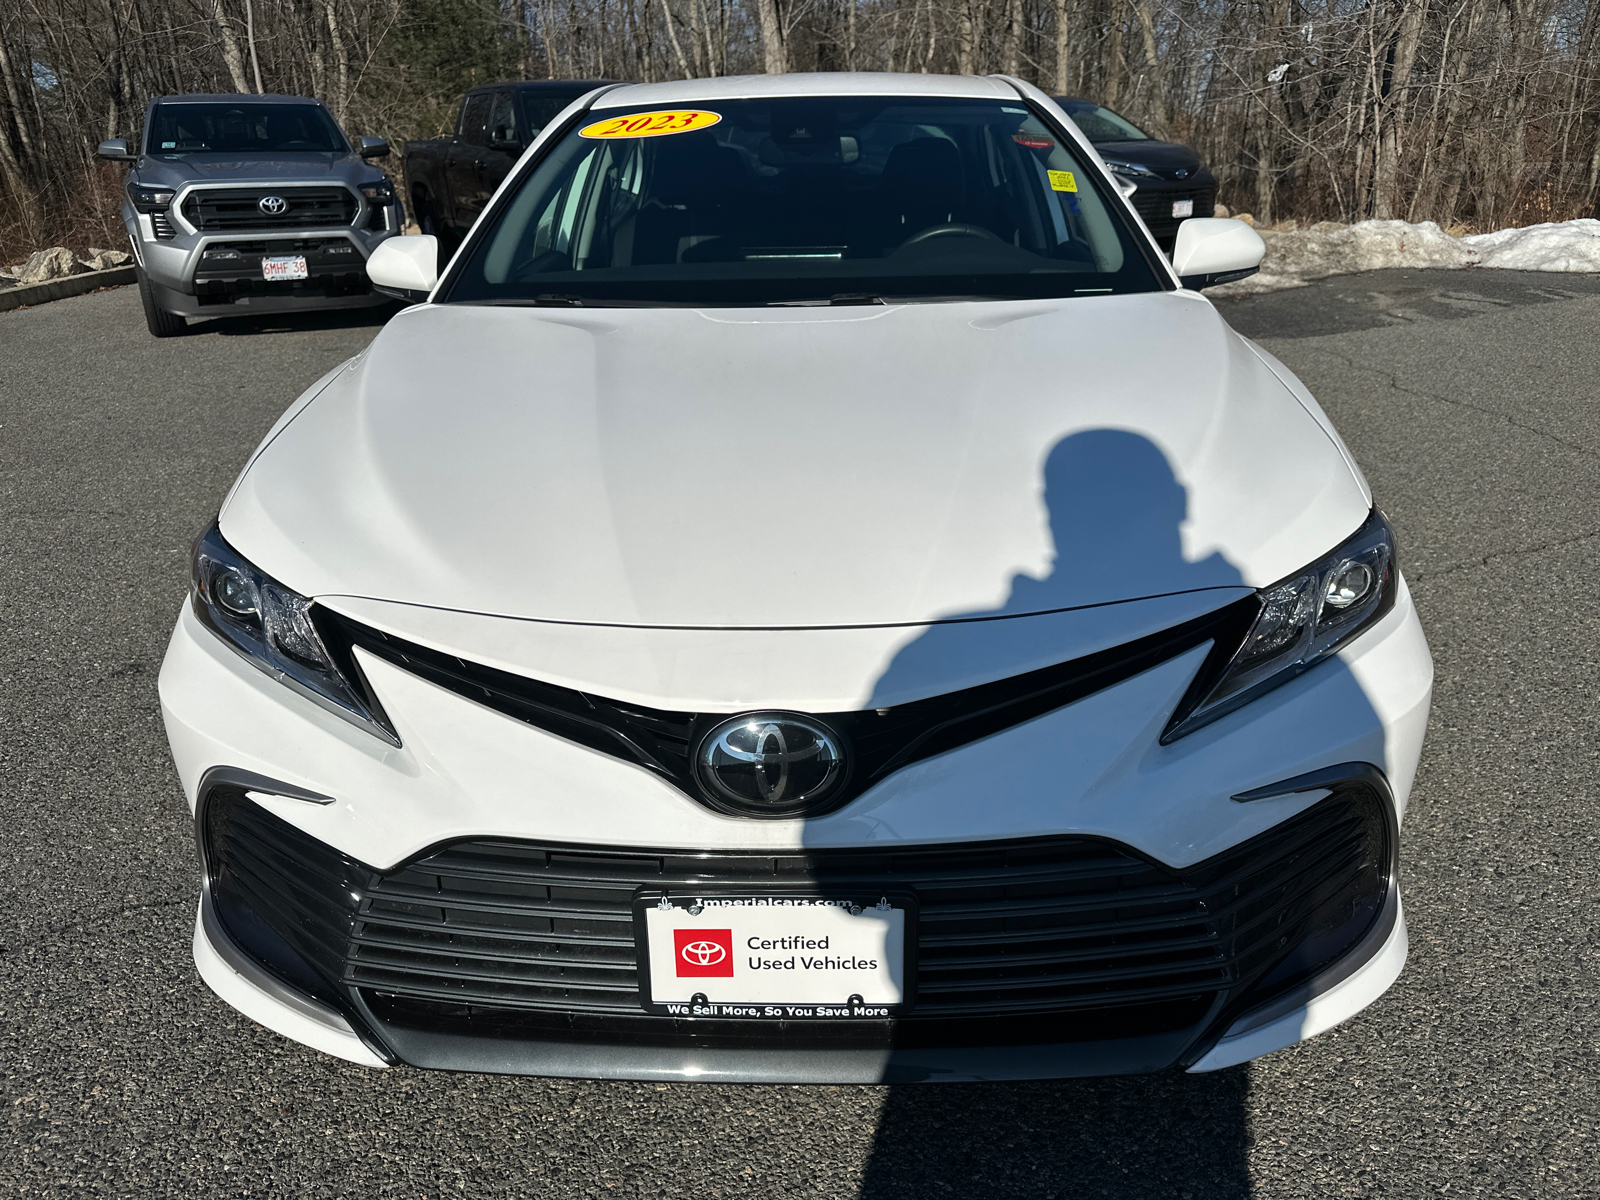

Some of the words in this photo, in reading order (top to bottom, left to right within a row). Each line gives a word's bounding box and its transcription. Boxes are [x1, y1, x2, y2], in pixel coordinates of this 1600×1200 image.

[599, 113, 698, 135] 2023
[264, 262, 288, 275] 6MHF
[293, 261, 306, 273] 38
[695, 897, 852, 907] Imperialcars.com
[747, 935, 829, 950] Certified
[748, 956, 795, 970] Used
[800, 956, 878, 970] Vehicles
[667, 1004, 689, 1014] We
[692, 1005, 718, 1015] Sell
[722, 1006, 761, 1018] More,
[764, 1006, 783, 1016] So
[786, 1006, 812, 1016] You
[816, 1006, 850, 1016] Save
[853, 1006, 888, 1016] More
